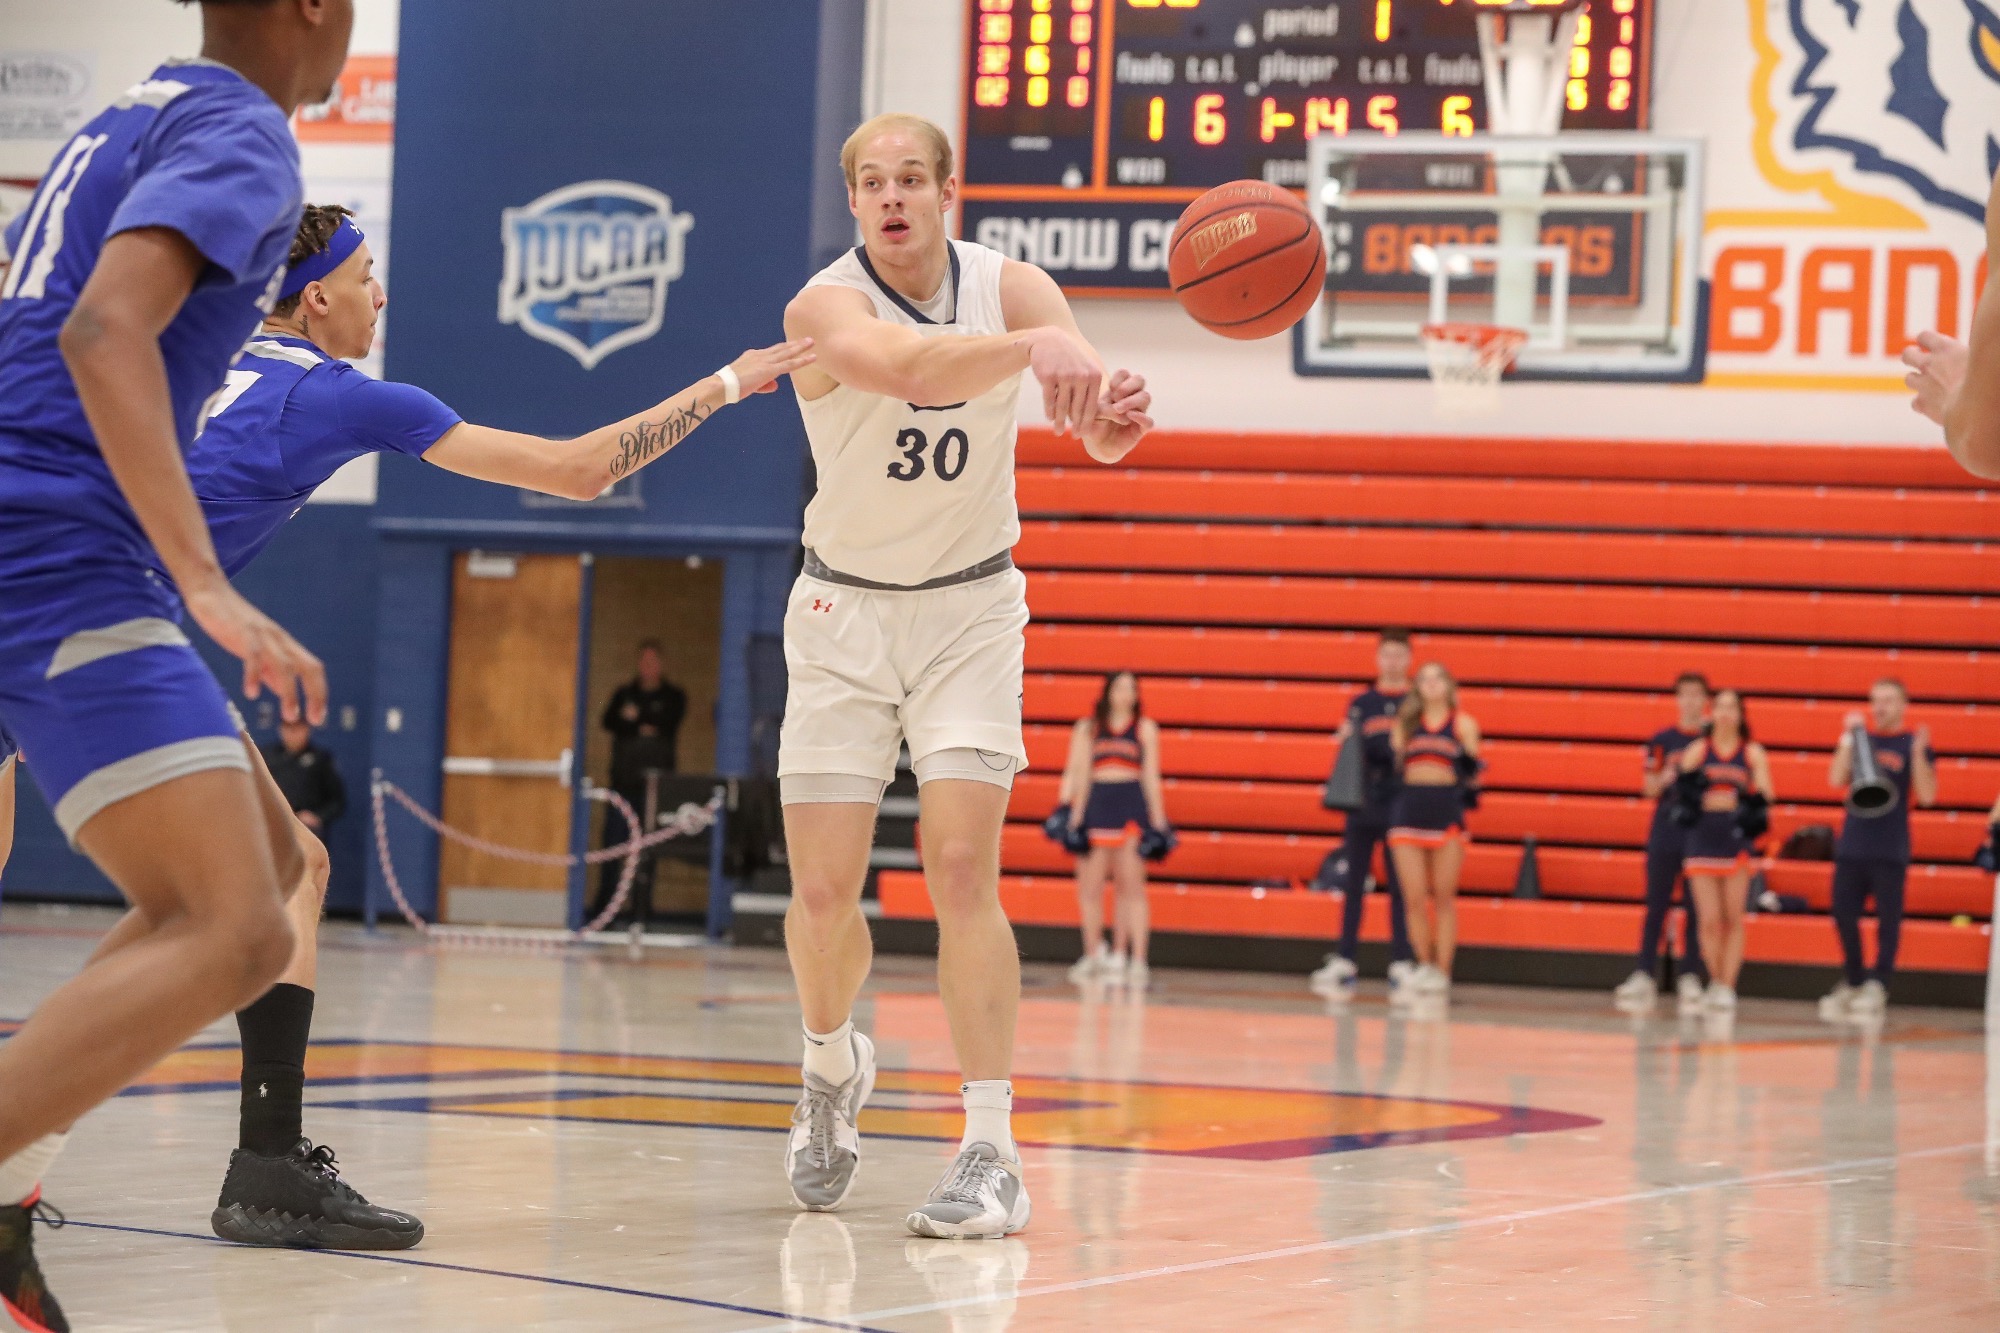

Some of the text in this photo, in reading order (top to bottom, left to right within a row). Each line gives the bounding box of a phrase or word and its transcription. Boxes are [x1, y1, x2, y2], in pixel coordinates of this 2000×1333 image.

[1193, 94, 1226, 145] 6
[513, 218, 669, 298] NJCAA
[610, 398, 706, 478] Phoenix
[887, 427, 969, 482] 30
